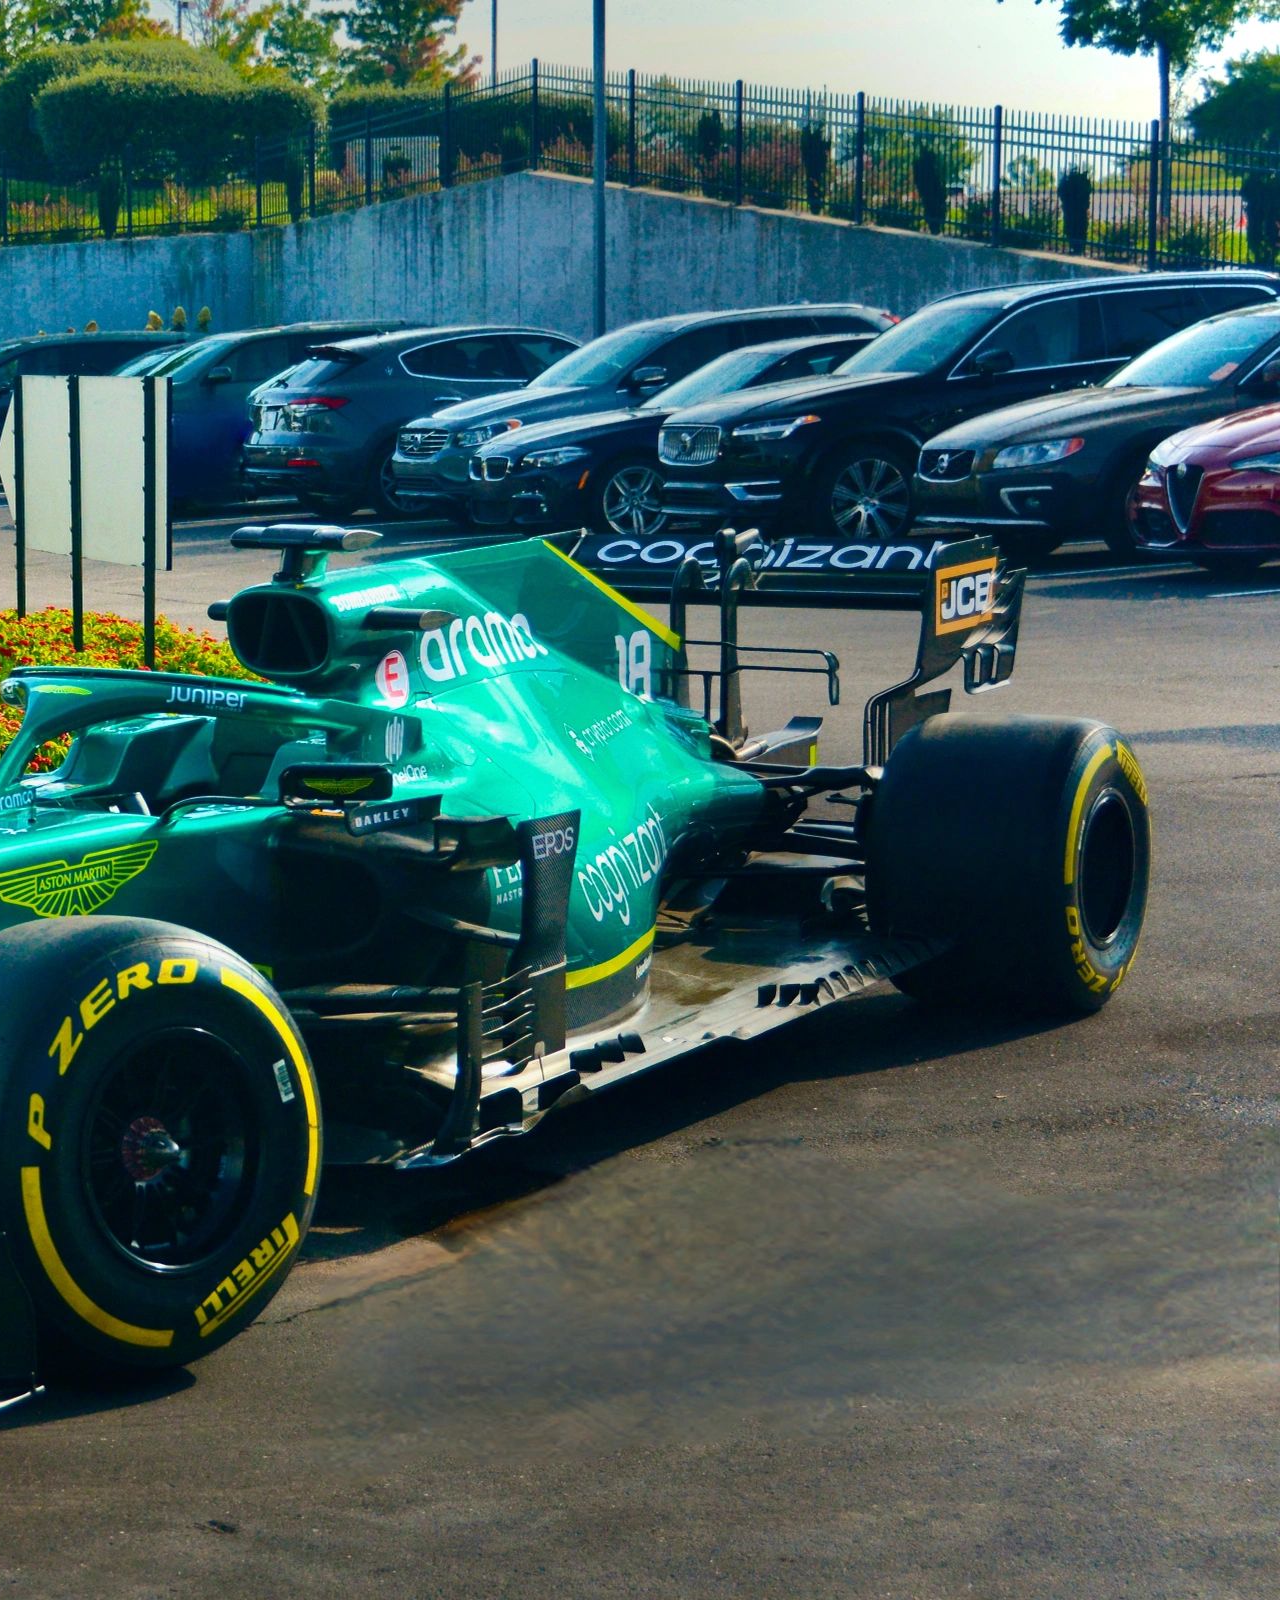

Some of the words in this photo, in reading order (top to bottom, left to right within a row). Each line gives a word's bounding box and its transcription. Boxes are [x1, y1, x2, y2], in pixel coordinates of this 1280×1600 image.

[941, 572, 992, 620] JCB
[615, 630, 654, 704] 18
[582, 709, 632, 747] crypto.com
[355, 808, 410, 828] OAKLEY
[531, 827, 575, 860] EPOS
[39, 874, 71, 892] ASTON
[73, 864, 111, 883] MARTIN
[577, 802, 668, 926] cognizant
[1065, 905, 1108, 993] ZERO
[28, 1093, 52, 1150] P
[48, 958, 199, 1076] ZERO
[193, 1211, 300, 1337] PIRELLI
